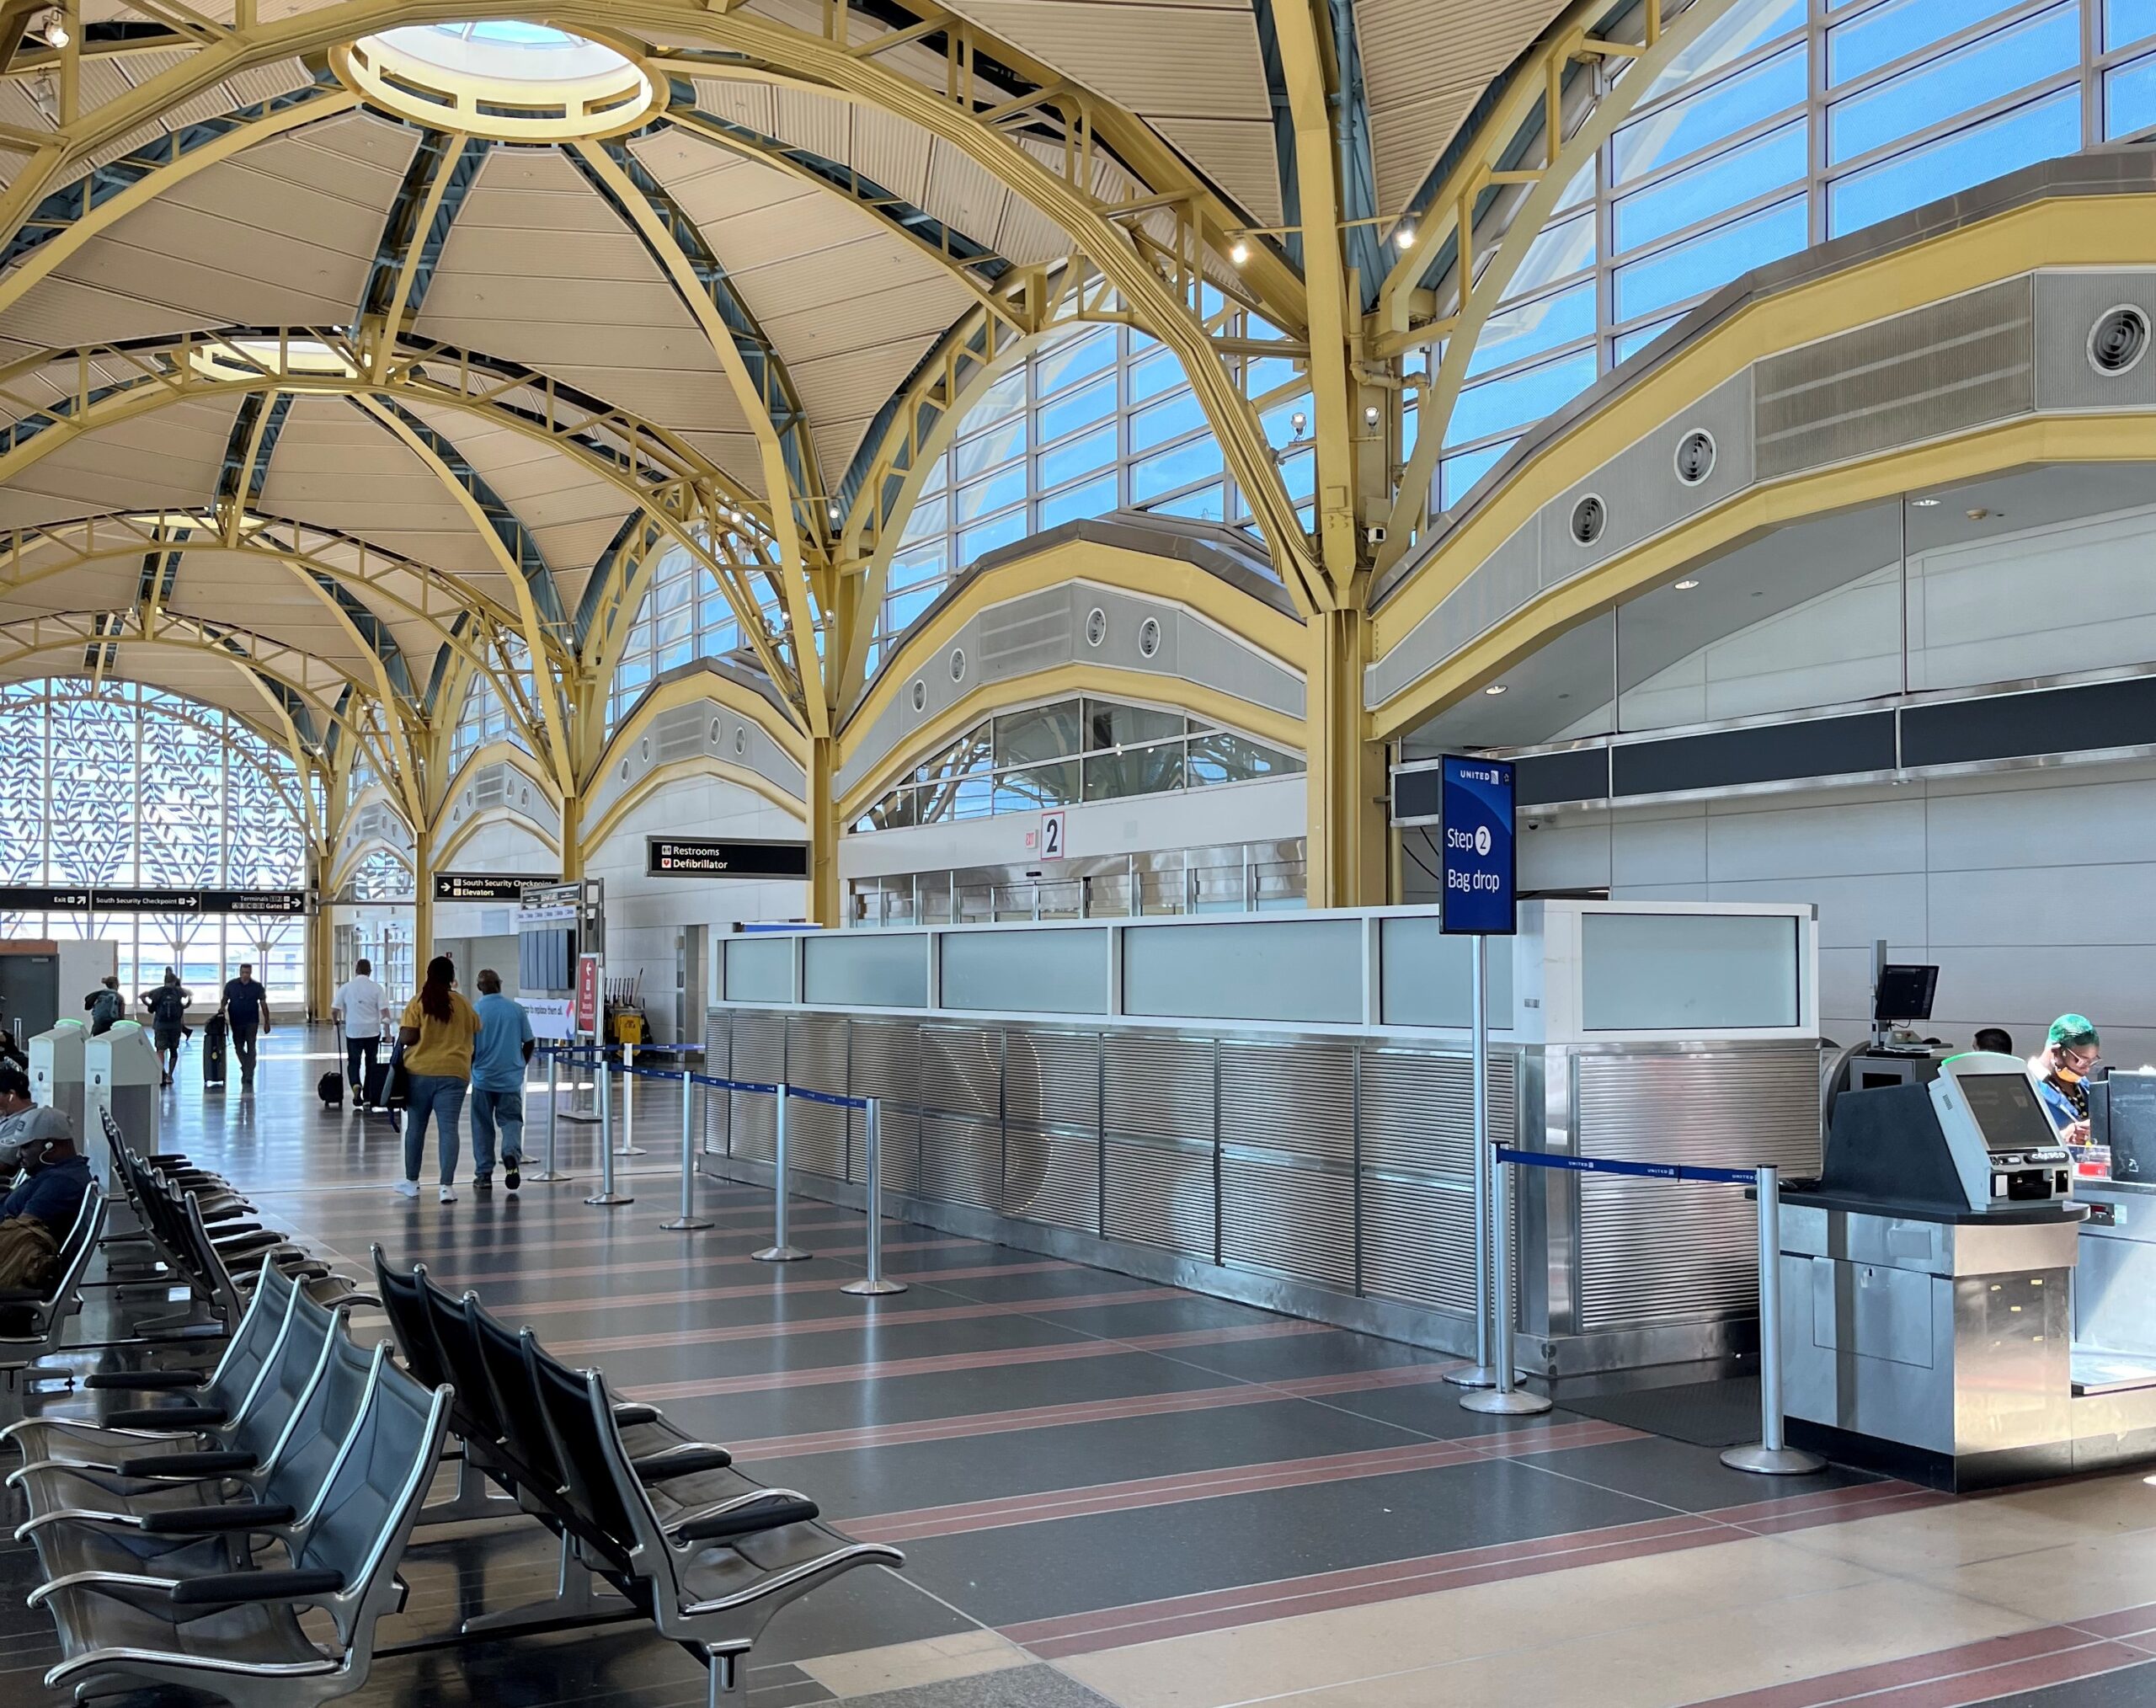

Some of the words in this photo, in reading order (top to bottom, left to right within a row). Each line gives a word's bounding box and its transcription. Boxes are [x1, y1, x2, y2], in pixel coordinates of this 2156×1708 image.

[1460, 770, 1490, 781] UNITED
[1047, 819, 1058, 852] 2
[1447, 828, 1473, 851] Step
[1480, 830, 1487, 850] 2
[673, 846, 719, 856] Restrooms
[673, 859, 728, 869] Defibrillator
[462, 878, 483, 887] South
[484, 879, 512, 889] Security
[1448, 869, 1470, 893] Bag
[1473, 869, 1500, 893] drop
[142, 897, 177, 905] Checkpoint
